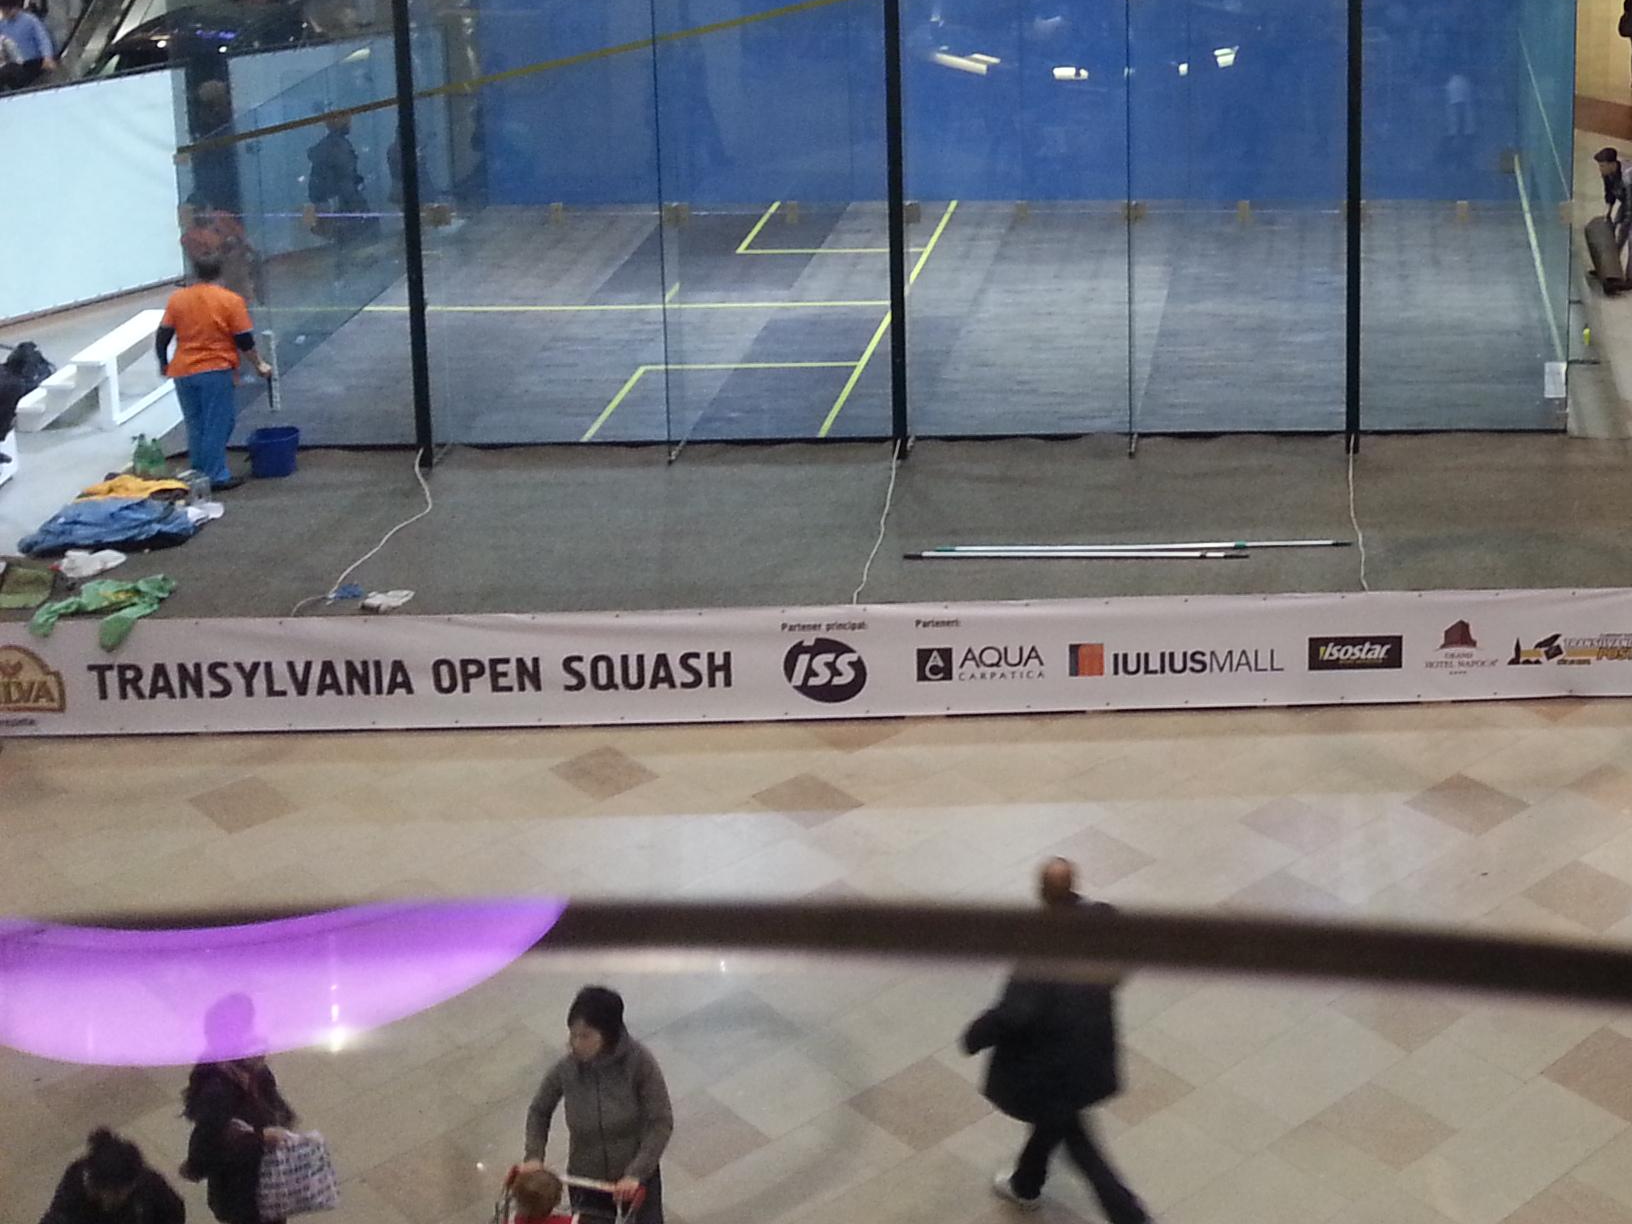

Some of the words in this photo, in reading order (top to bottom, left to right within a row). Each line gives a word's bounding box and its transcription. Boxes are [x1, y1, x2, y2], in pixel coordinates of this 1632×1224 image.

[780, 621, 822, 632] Partener
[958, 644, 1044, 669] AQUA
[1112, 648, 1285, 676] IULIUSMALL
[1321, 641, 1392, 661] Isostar
[87, 659, 415, 701] TRANSYLVANIA
[431, 656, 542, 695] OPEN
[561, 651, 732, 692] SQUASH
[958, 670, 1046, 682] CARPATICA
